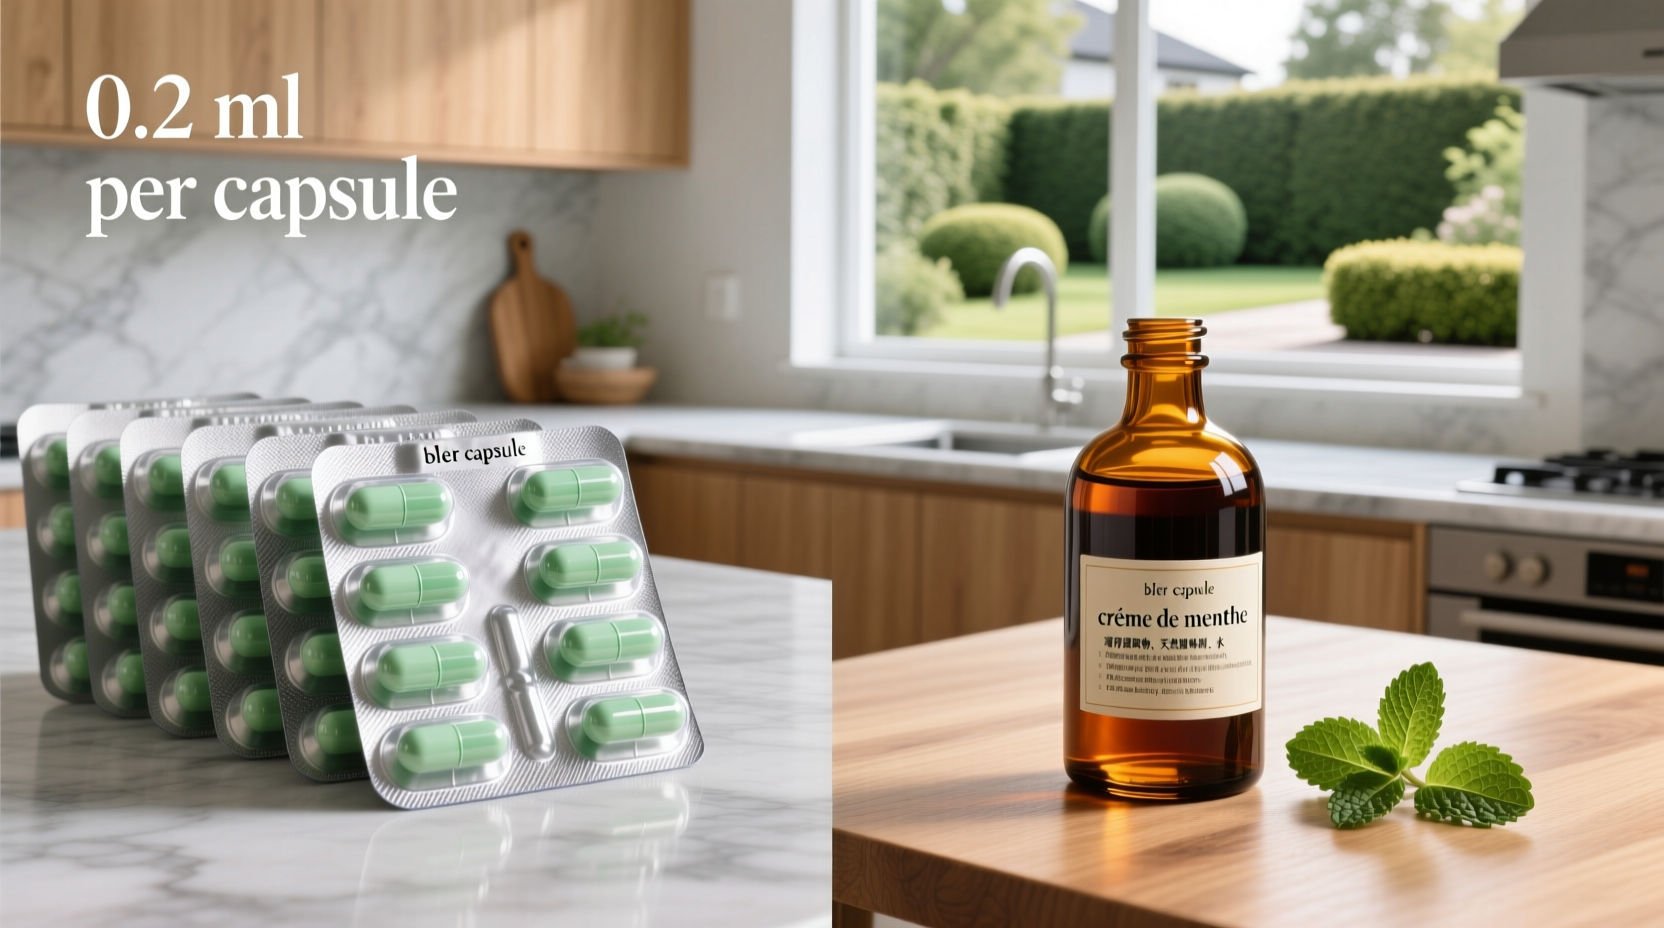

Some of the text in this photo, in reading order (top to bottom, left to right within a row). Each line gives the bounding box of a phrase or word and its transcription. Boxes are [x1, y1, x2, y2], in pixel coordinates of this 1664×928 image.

[423, 437, 526, 465] bler capsule
[1097, 605, 1249, 628] créme de menthe
